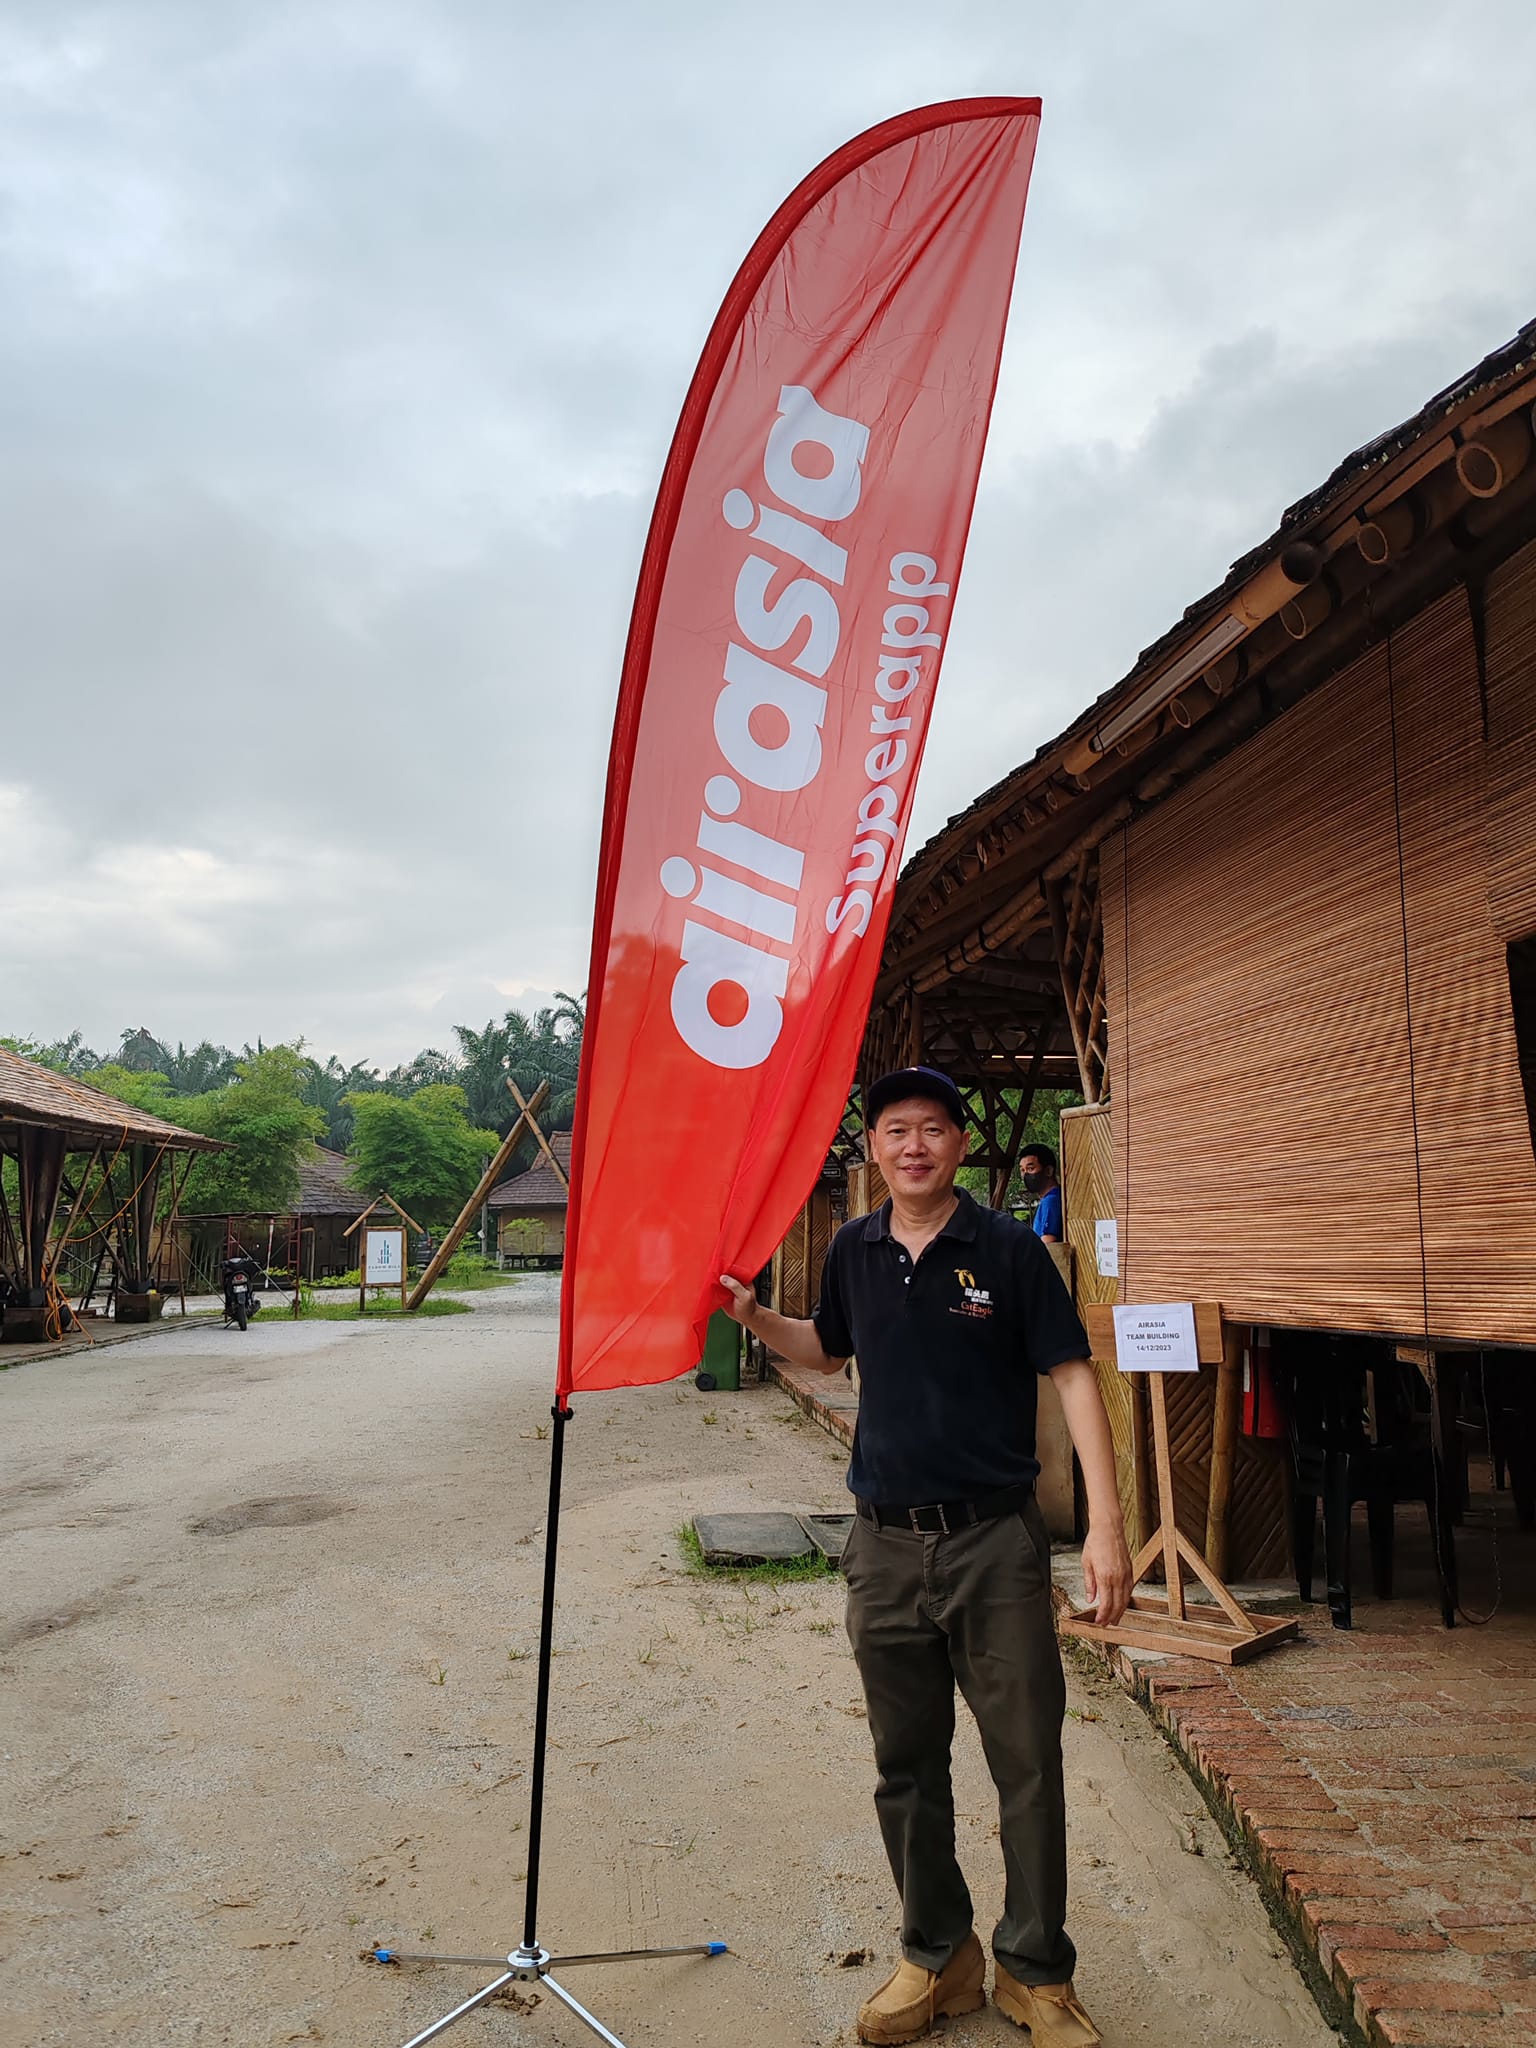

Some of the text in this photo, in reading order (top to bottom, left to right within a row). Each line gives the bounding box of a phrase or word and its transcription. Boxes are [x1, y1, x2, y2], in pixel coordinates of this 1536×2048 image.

[660, 384, 871, 1069] airasia
[825, 551, 950, 938] superapp
[1136, 1344, 1172, 1352] 14/12/2023
[1146, 1332, 1180, 1340] BUILDING
